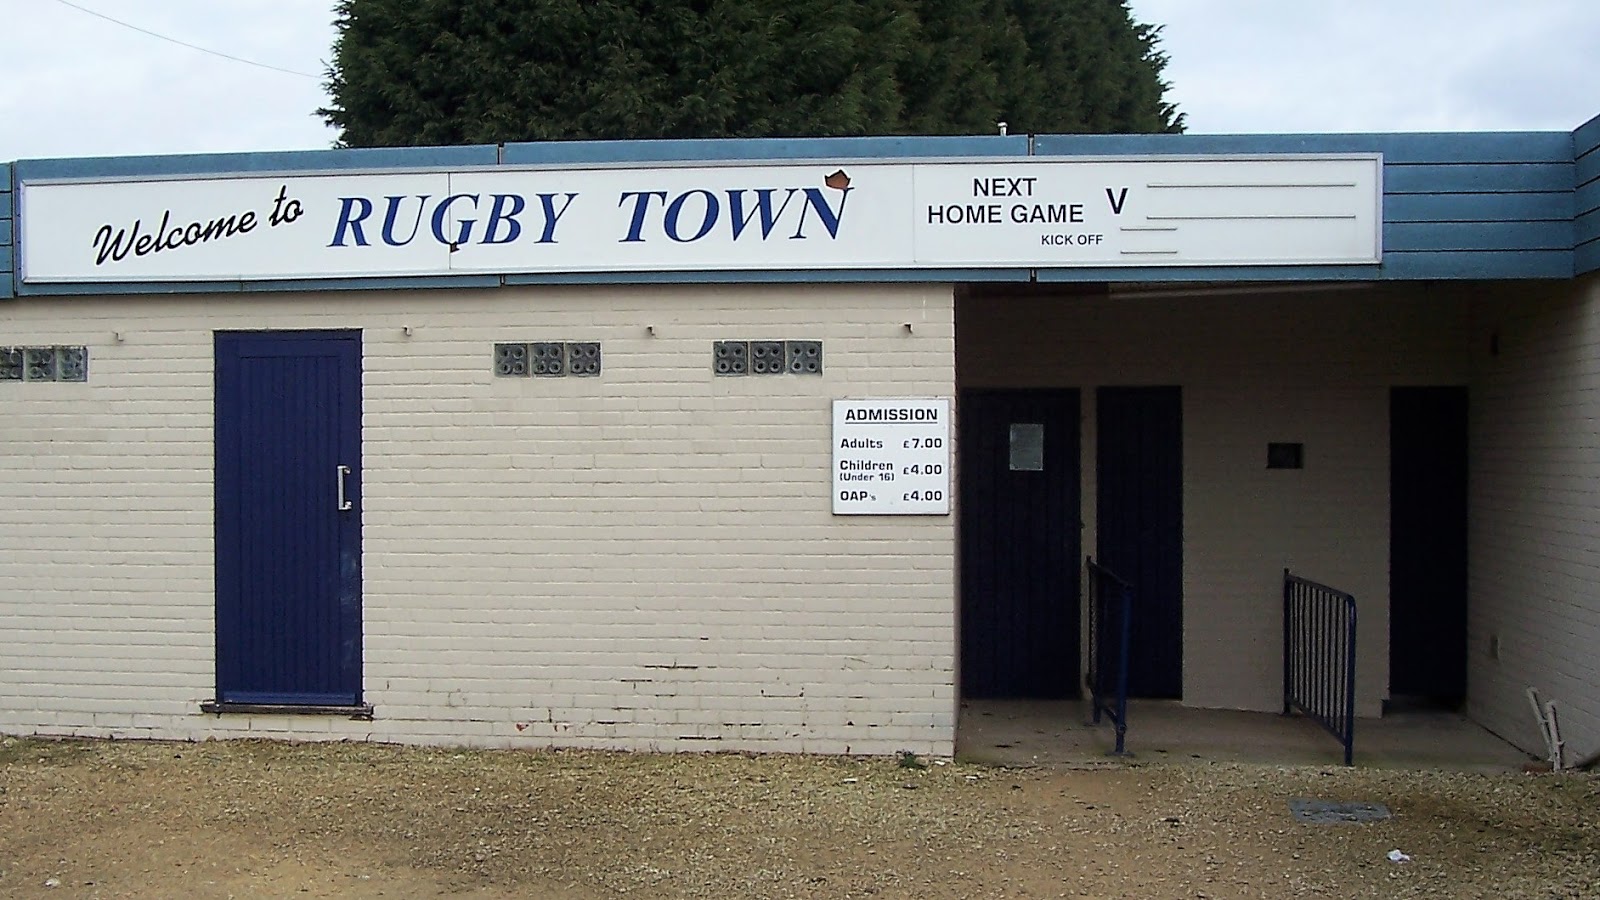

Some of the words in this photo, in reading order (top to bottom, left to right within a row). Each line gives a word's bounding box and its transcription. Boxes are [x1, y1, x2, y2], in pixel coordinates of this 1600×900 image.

[973, 178, 1037, 196] NEXT
[1106, 188, 1128, 214] V
[928, 205, 1002, 224] HOME
[1010, 204, 1084, 224] GAME
[93, 210, 258, 265] Welcome
[269, 185, 304, 224] to
[326, 192, 579, 247] RUGBY
[617, 187, 854, 243] TOWN
[1041, 235, 1073, 245] KICK
[1077, 234, 1103, 245] OFF
[845, 409, 938, 420] ADMISSION
[840, 438, 883, 448] Adults
[903, 438, 942, 448] £7.00
[840, 460, 893, 470] Children
[903, 465, 942, 475] £4.00
[840, 473, 874, 481] (Under
[879, 473, 895, 481] 16)
[903, 491, 942, 501] £4.00
